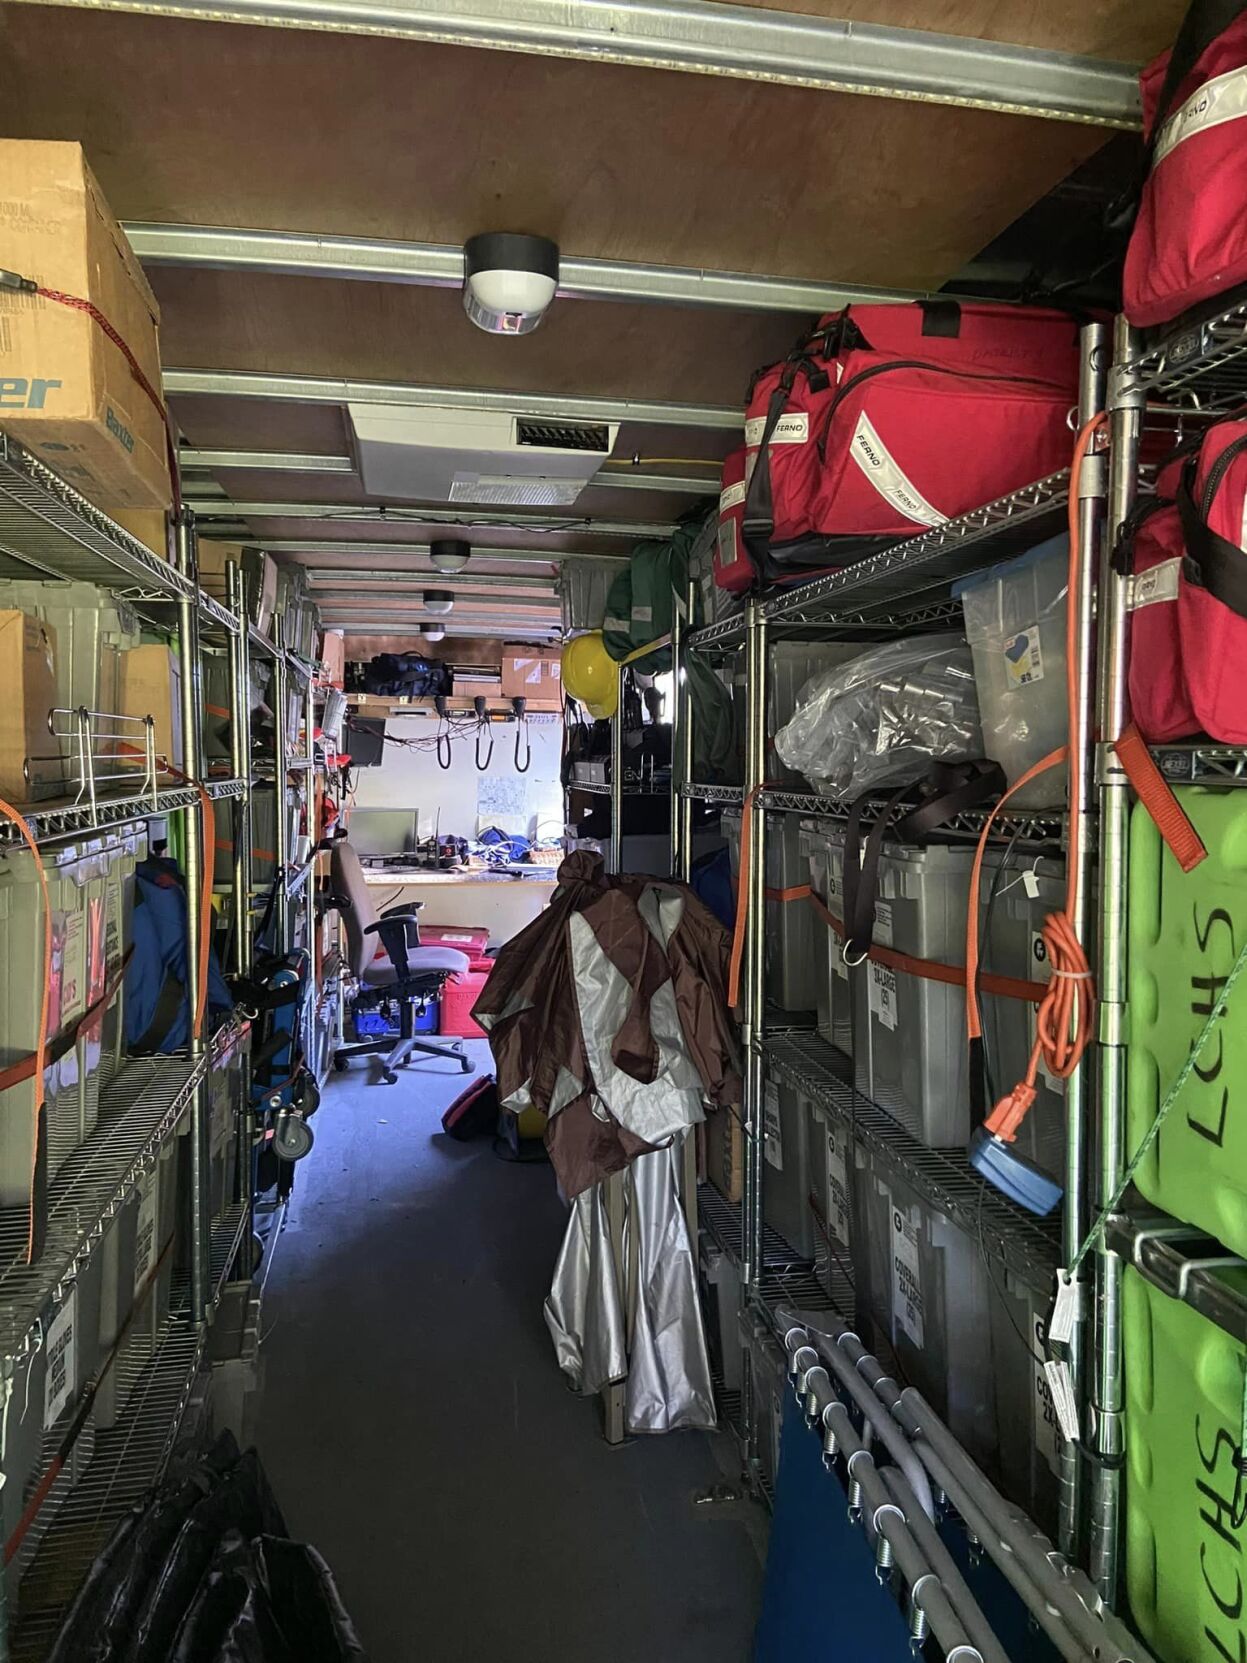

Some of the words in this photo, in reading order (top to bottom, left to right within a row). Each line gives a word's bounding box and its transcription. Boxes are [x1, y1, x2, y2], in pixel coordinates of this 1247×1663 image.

[106, 406, 135, 454] Baxter
[776, 423, 803, 432] FERNO
[857, 435, 880, 466] FERNO
[895, 489, 917, 510] FERNO
[1187, 900, 1236, 1148] LCHS
